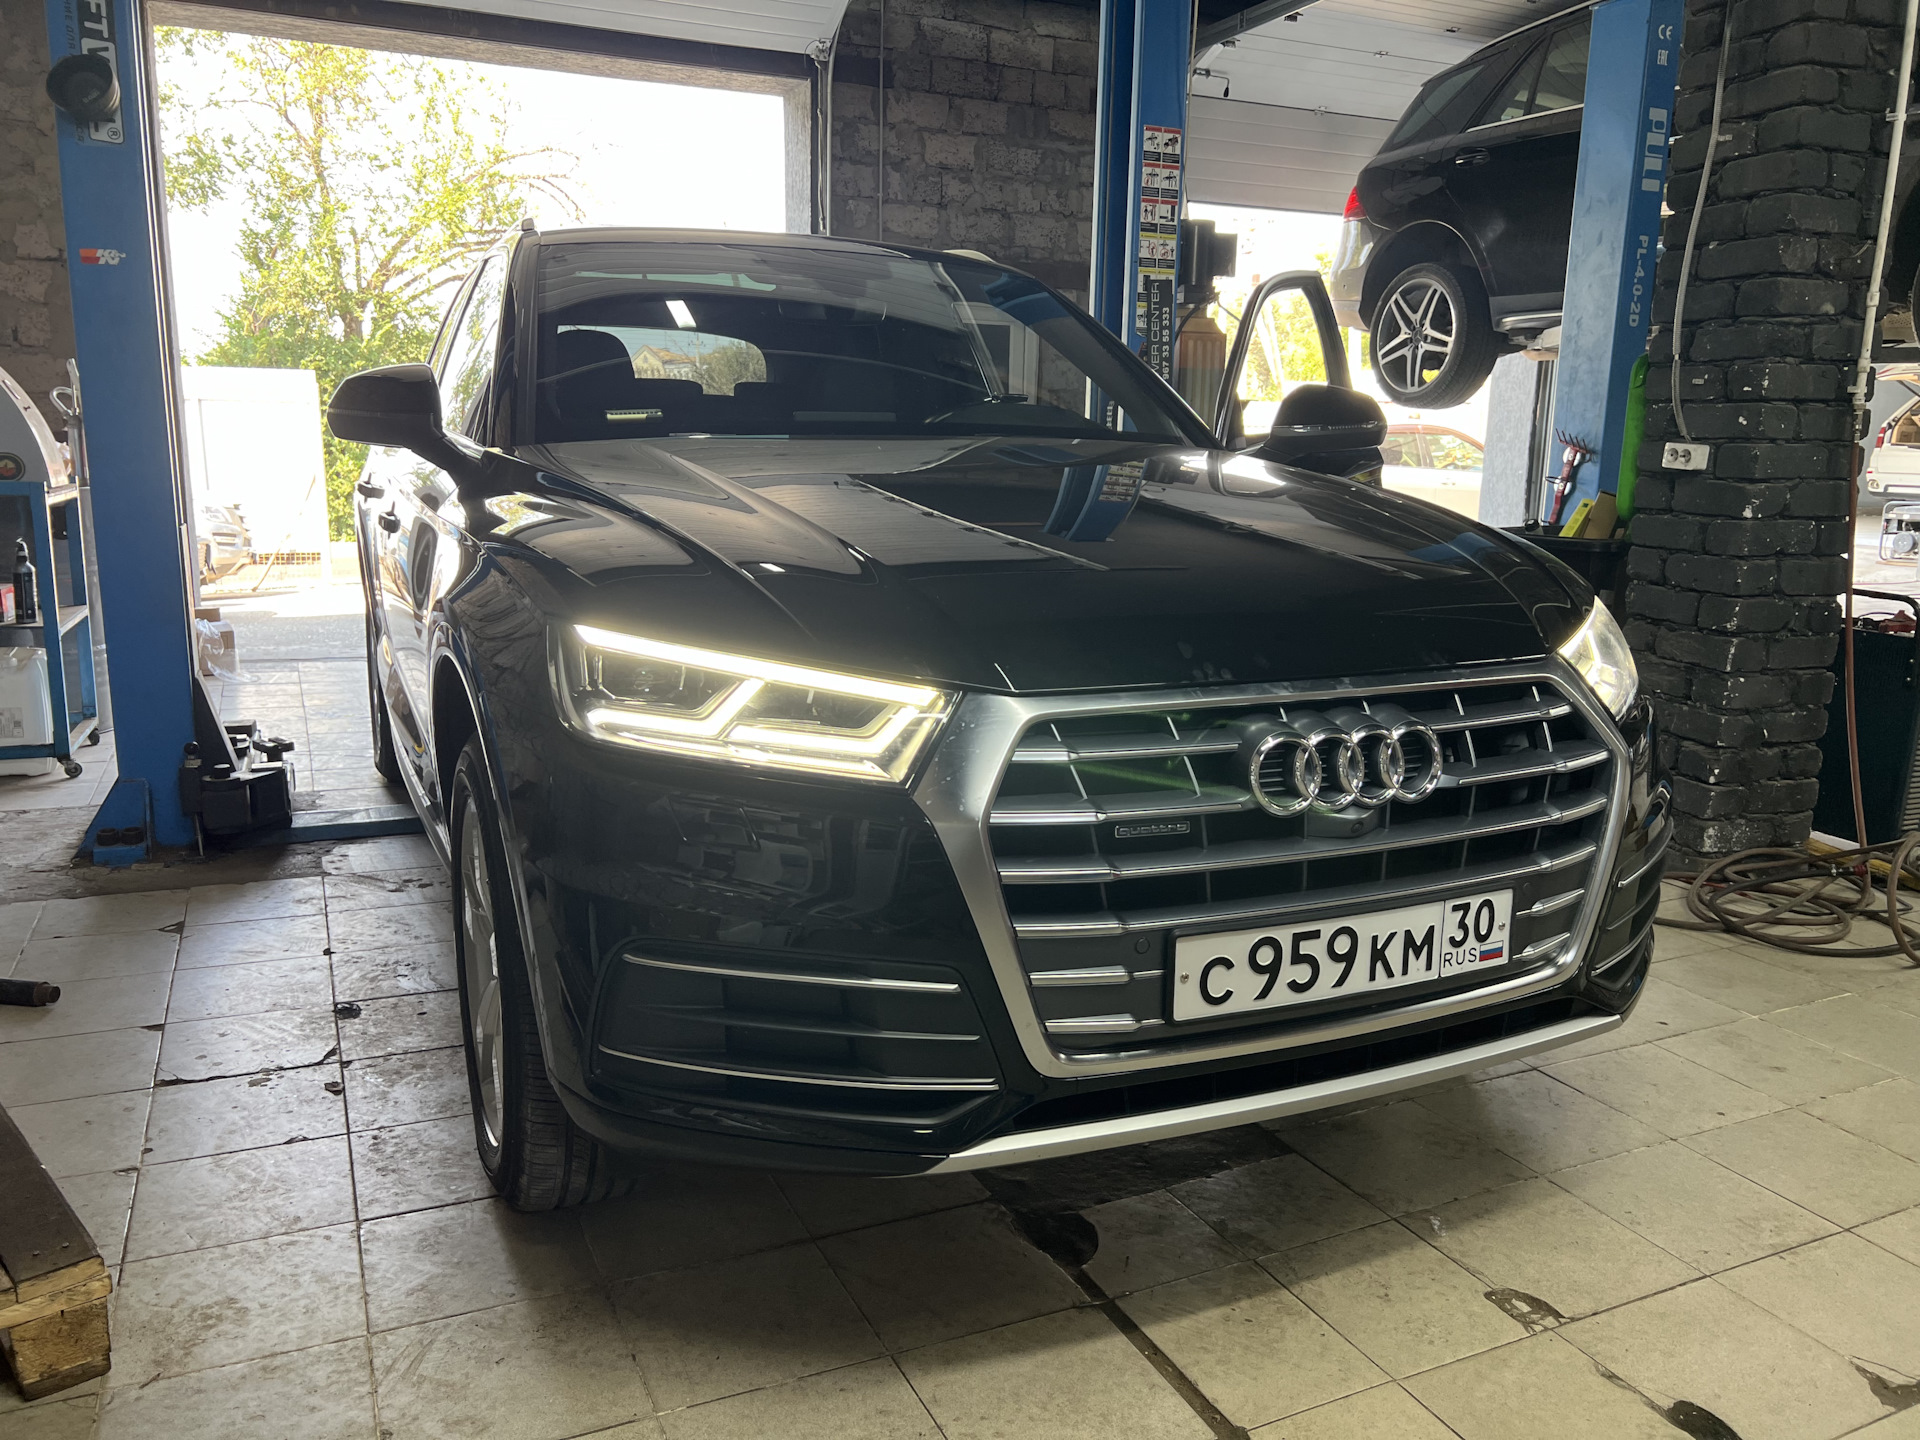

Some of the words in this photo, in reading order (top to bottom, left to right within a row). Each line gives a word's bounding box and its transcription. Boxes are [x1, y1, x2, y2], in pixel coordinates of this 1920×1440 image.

[1151, 282, 1160, 342] CENTER
[1162, 307, 1170, 327] 333
[1162, 329, 1170, 342] 55
[1162, 345, 1170, 358] 33
[1448, 898, 1495, 949] 30
[1442, 947, 1478, 968] RUS
